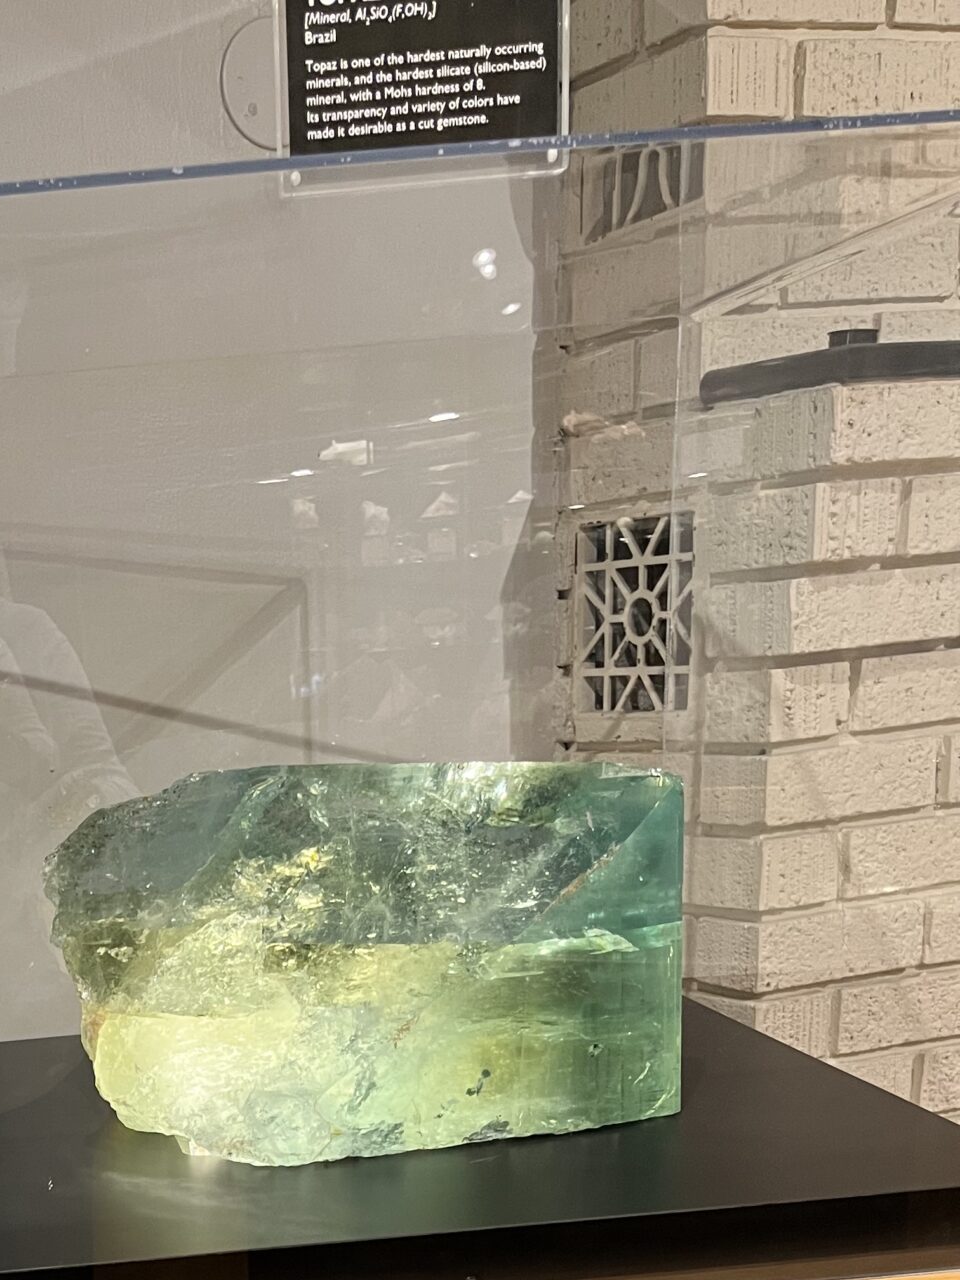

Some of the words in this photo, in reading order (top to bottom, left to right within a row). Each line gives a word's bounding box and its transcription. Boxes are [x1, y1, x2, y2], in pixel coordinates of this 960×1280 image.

[304, 9, 352, 29] [Mineral,
[304, 28, 337, 45] Brazil
[305, 59, 337, 75] Topaz
[340, 58, 348, 70] is
[351, 58, 371, 69] one
[374, 53, 385, 66] of
[387, 53, 404, 65] the
[407, 49, 445, 63] hardest
[448, 44, 492, 60] naturally
[494, 42, 544, 56] occurring
[306, 74, 351, 90] minerals,
[354, 71, 373, 85] and
[376, 70, 393, 83] the
[395, 67, 433, 82] hardest
[436, 65, 471, 78] silicate
[473, 56, 547, 77] (silicon-based)
[349, 88, 373, 102] with
[375, 90, 382, 100] a
[384, 85, 413, 99] Mohs
[415, 81, 460, 96] hardness
[462, 79, 474, 92] of
[476, 78, 486, 91] 8.
[306, 110, 320, 124] Its
[322, 106, 388, 123] transparency
[390, 101, 409, 115] and
[411, 98, 446, 114] variety
[448, 97, 460, 110] of
[462, 95, 494, 109] colors
[496, 93, 521, 106] have
[307, 126, 335, 140] made
[337, 125, 345, 137] it
[348, 121, 393, 136] desirable
[395, 120, 406, 132] as
[409, 120, 416, 130] a
[418, 117, 434, 129] cut
[436, 114, 489, 132] gemstone.
